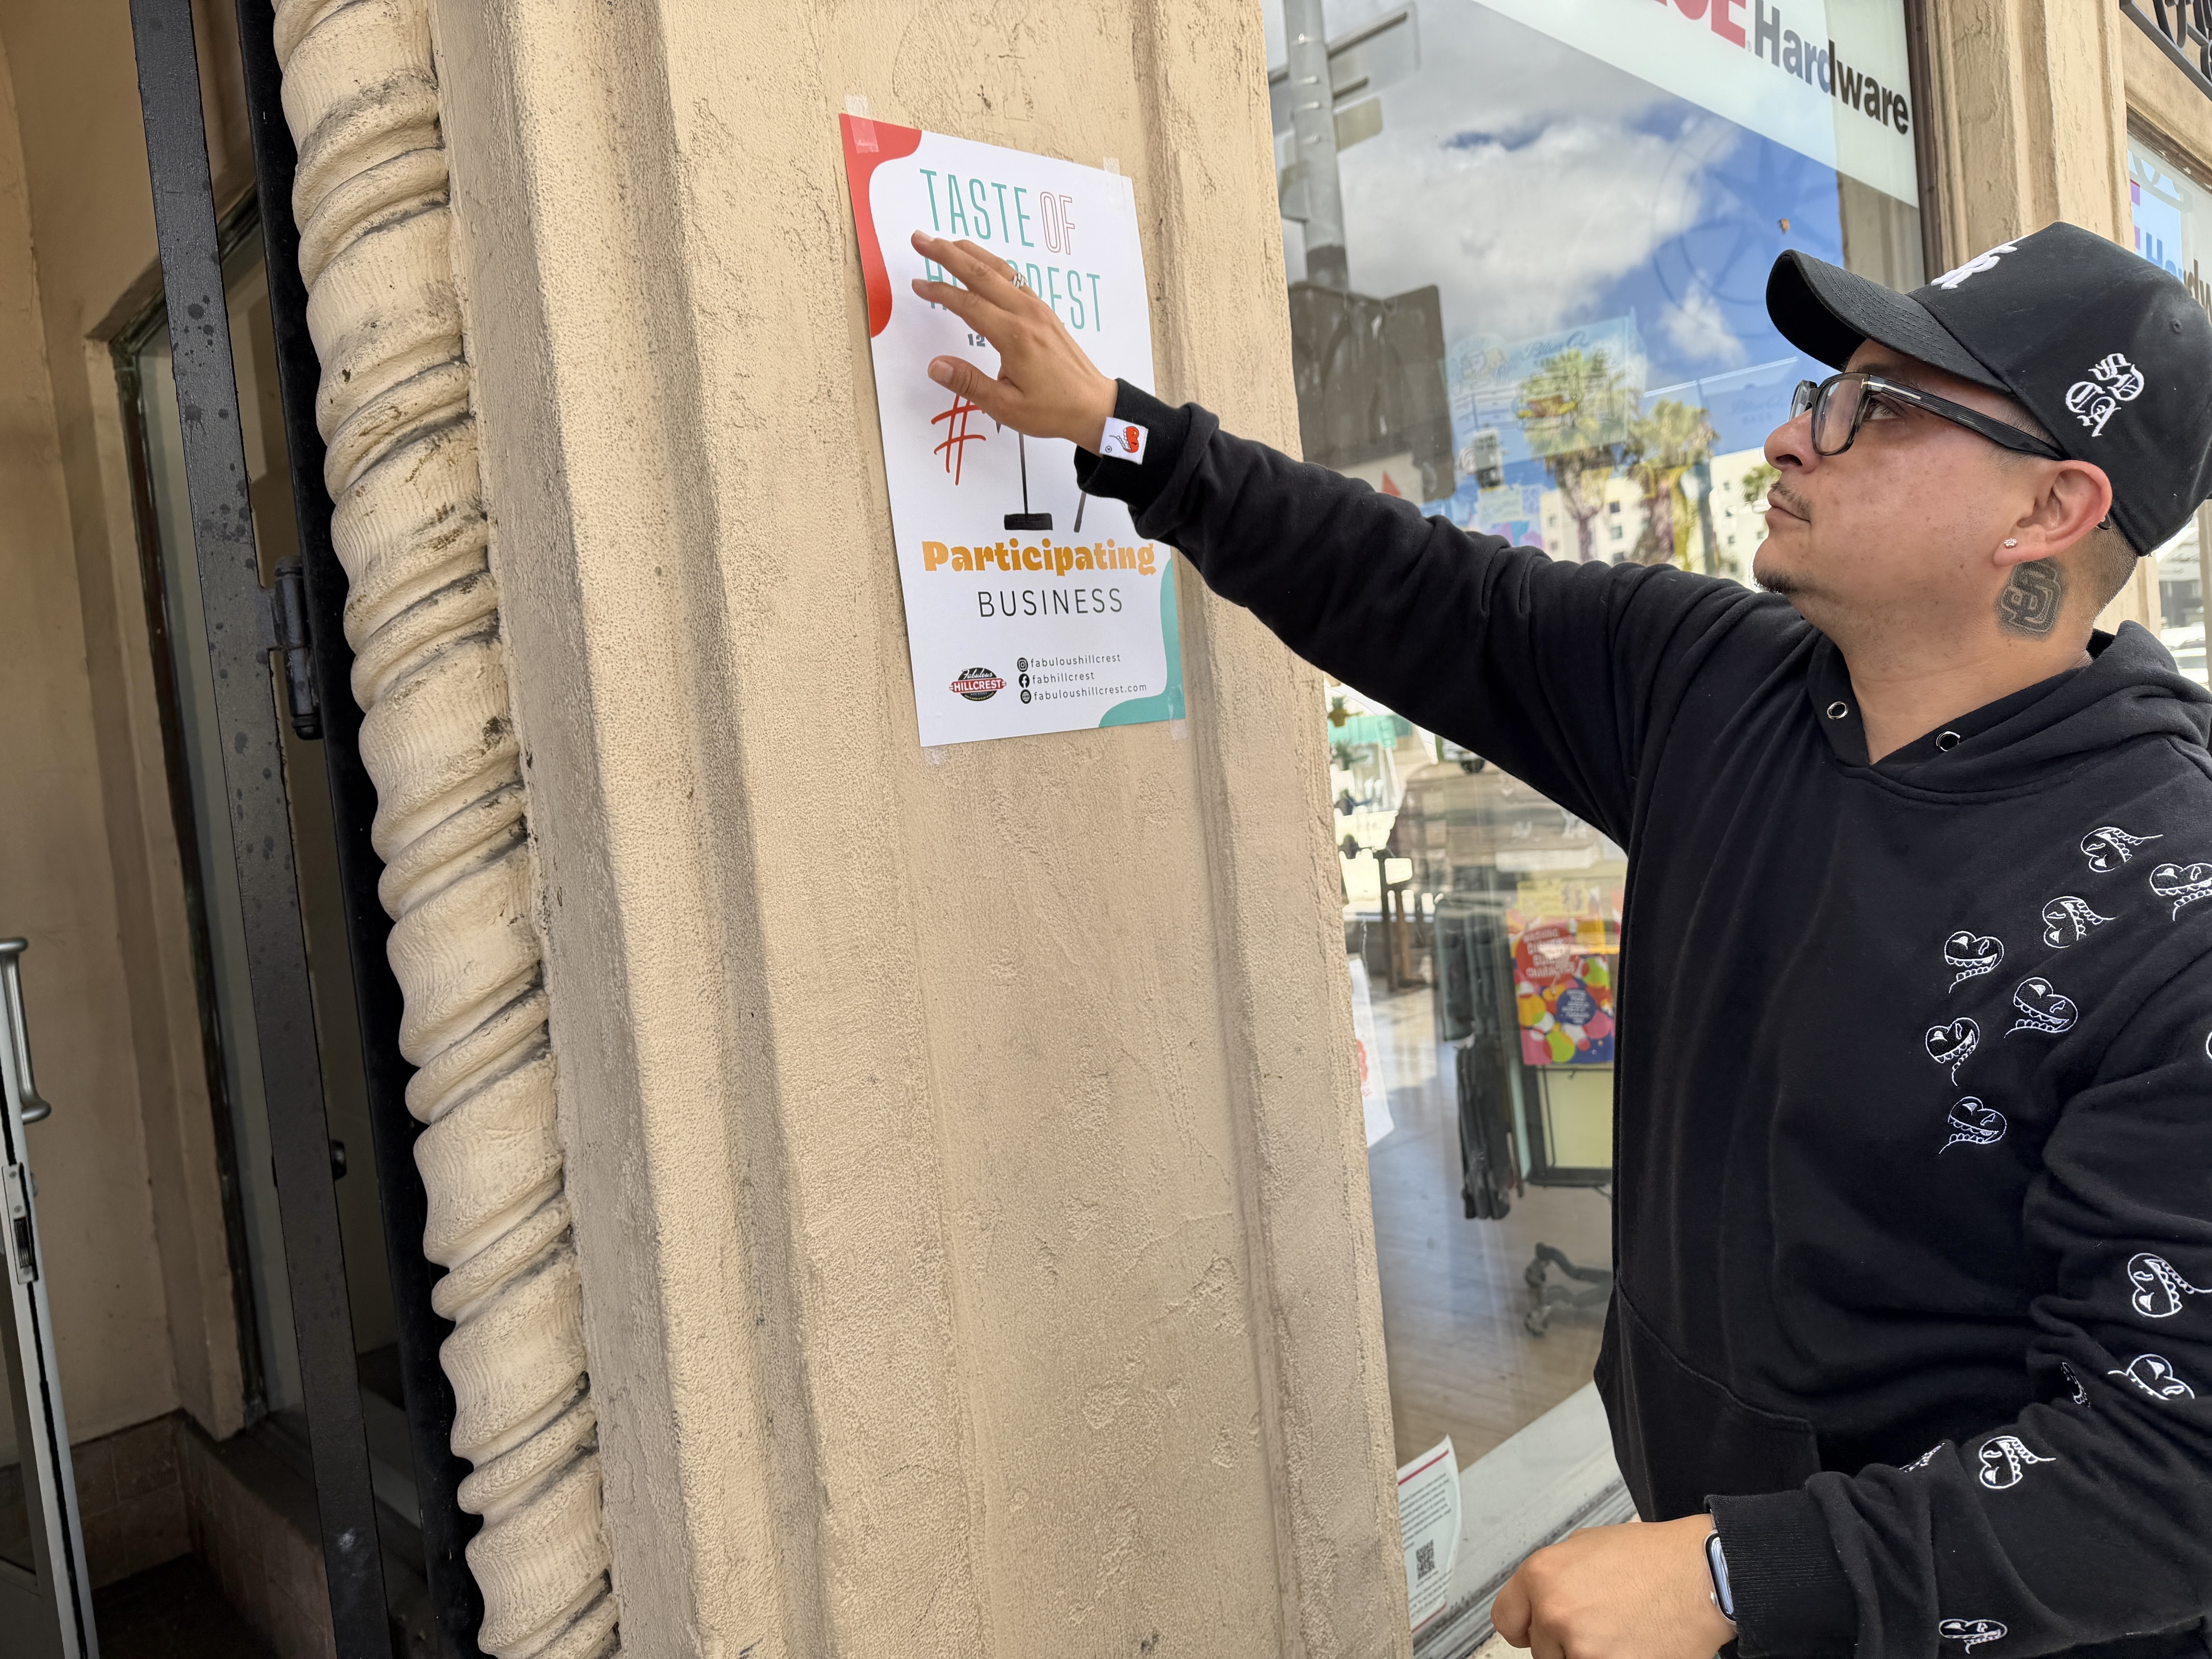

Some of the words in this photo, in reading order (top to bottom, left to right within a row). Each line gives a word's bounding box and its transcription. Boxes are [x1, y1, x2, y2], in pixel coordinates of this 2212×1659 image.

[1754, 0, 1910, 135] Hardware
[920, 169, 1034, 247] TASTE
[1040, 191, 1075, 255] OF
[922, 538, 1157, 576] Participating
[978, 588, 1122, 617] BUSINESS
[1031, 654, 1121, 668] fabuloushillcrest
[962, 668, 993, 680] Fabulous
[1032, 672, 1094, 684] fabhillcrest
[953, 679, 1001, 691] HILLCREST
[1034, 684, 1147, 701] fabuloushillcrest.com
